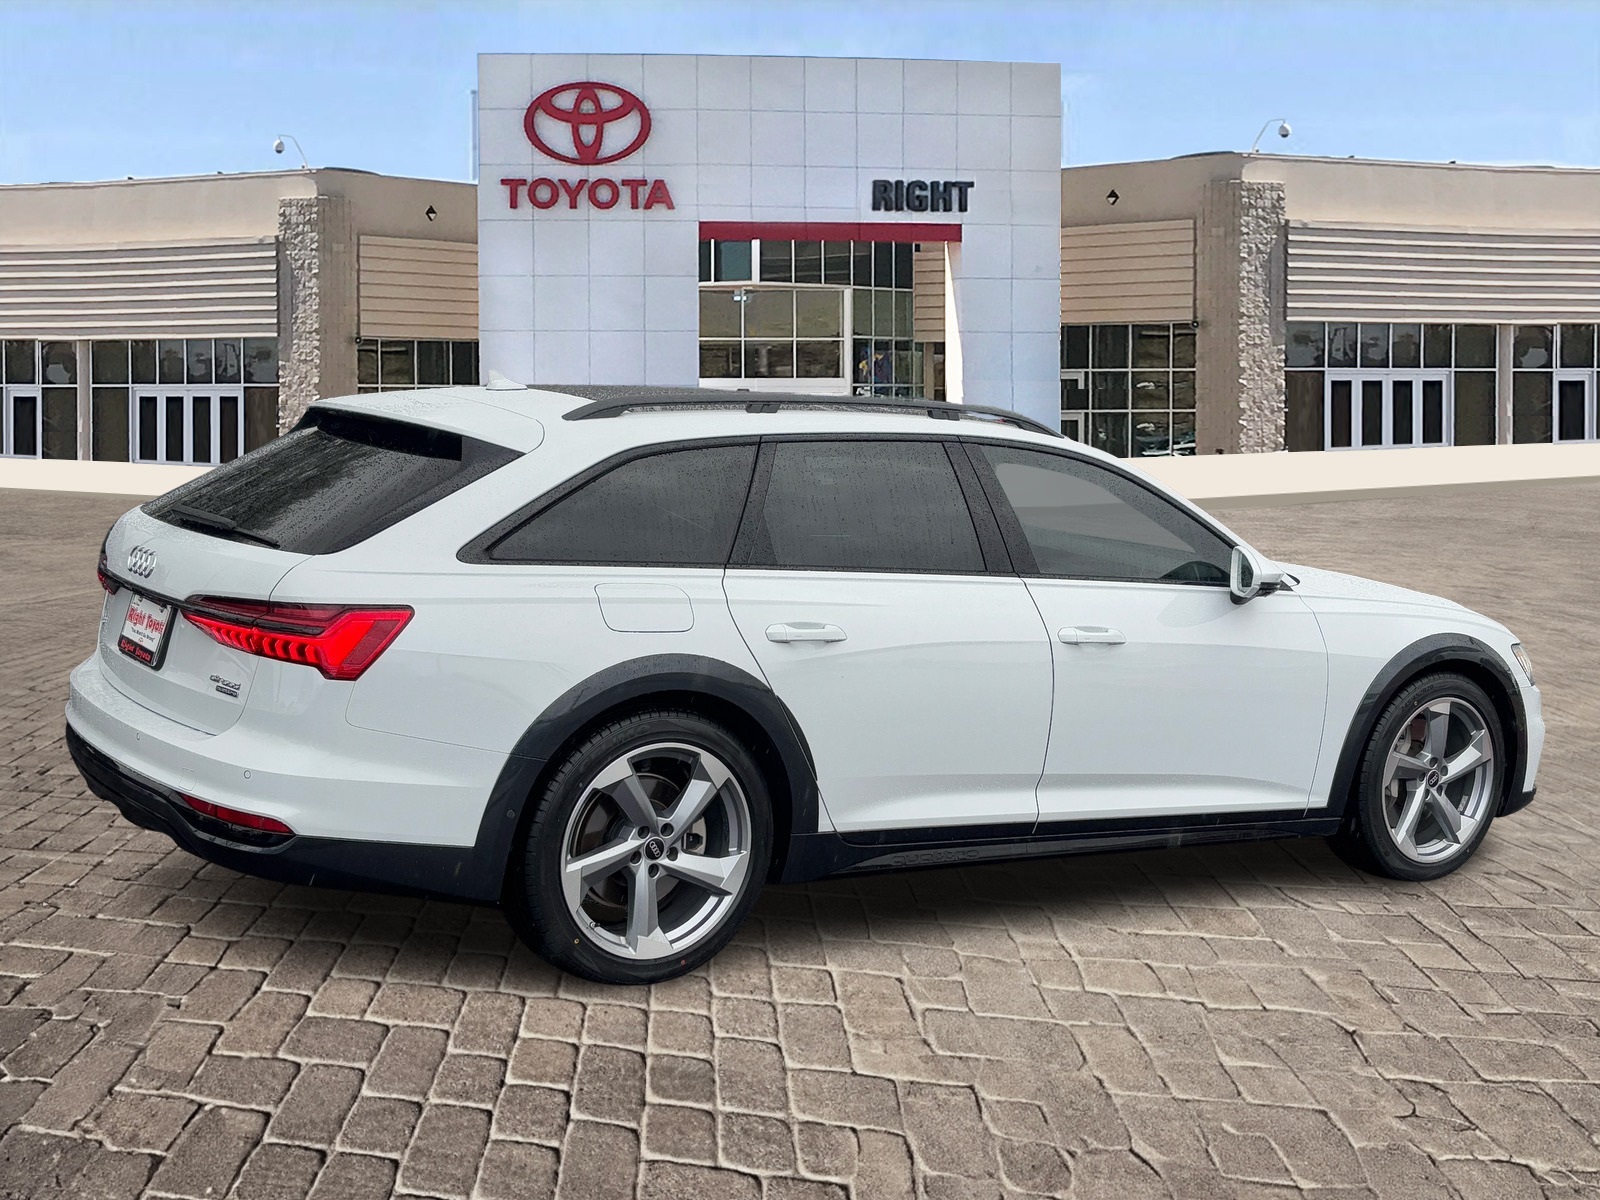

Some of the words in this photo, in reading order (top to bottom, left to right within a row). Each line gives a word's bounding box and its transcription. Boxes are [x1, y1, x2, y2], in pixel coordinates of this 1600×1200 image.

[500, 178, 675, 211] TOYOTA
[871, 180, 975, 213] RIGHT
[127, 606, 145, 626] Right
